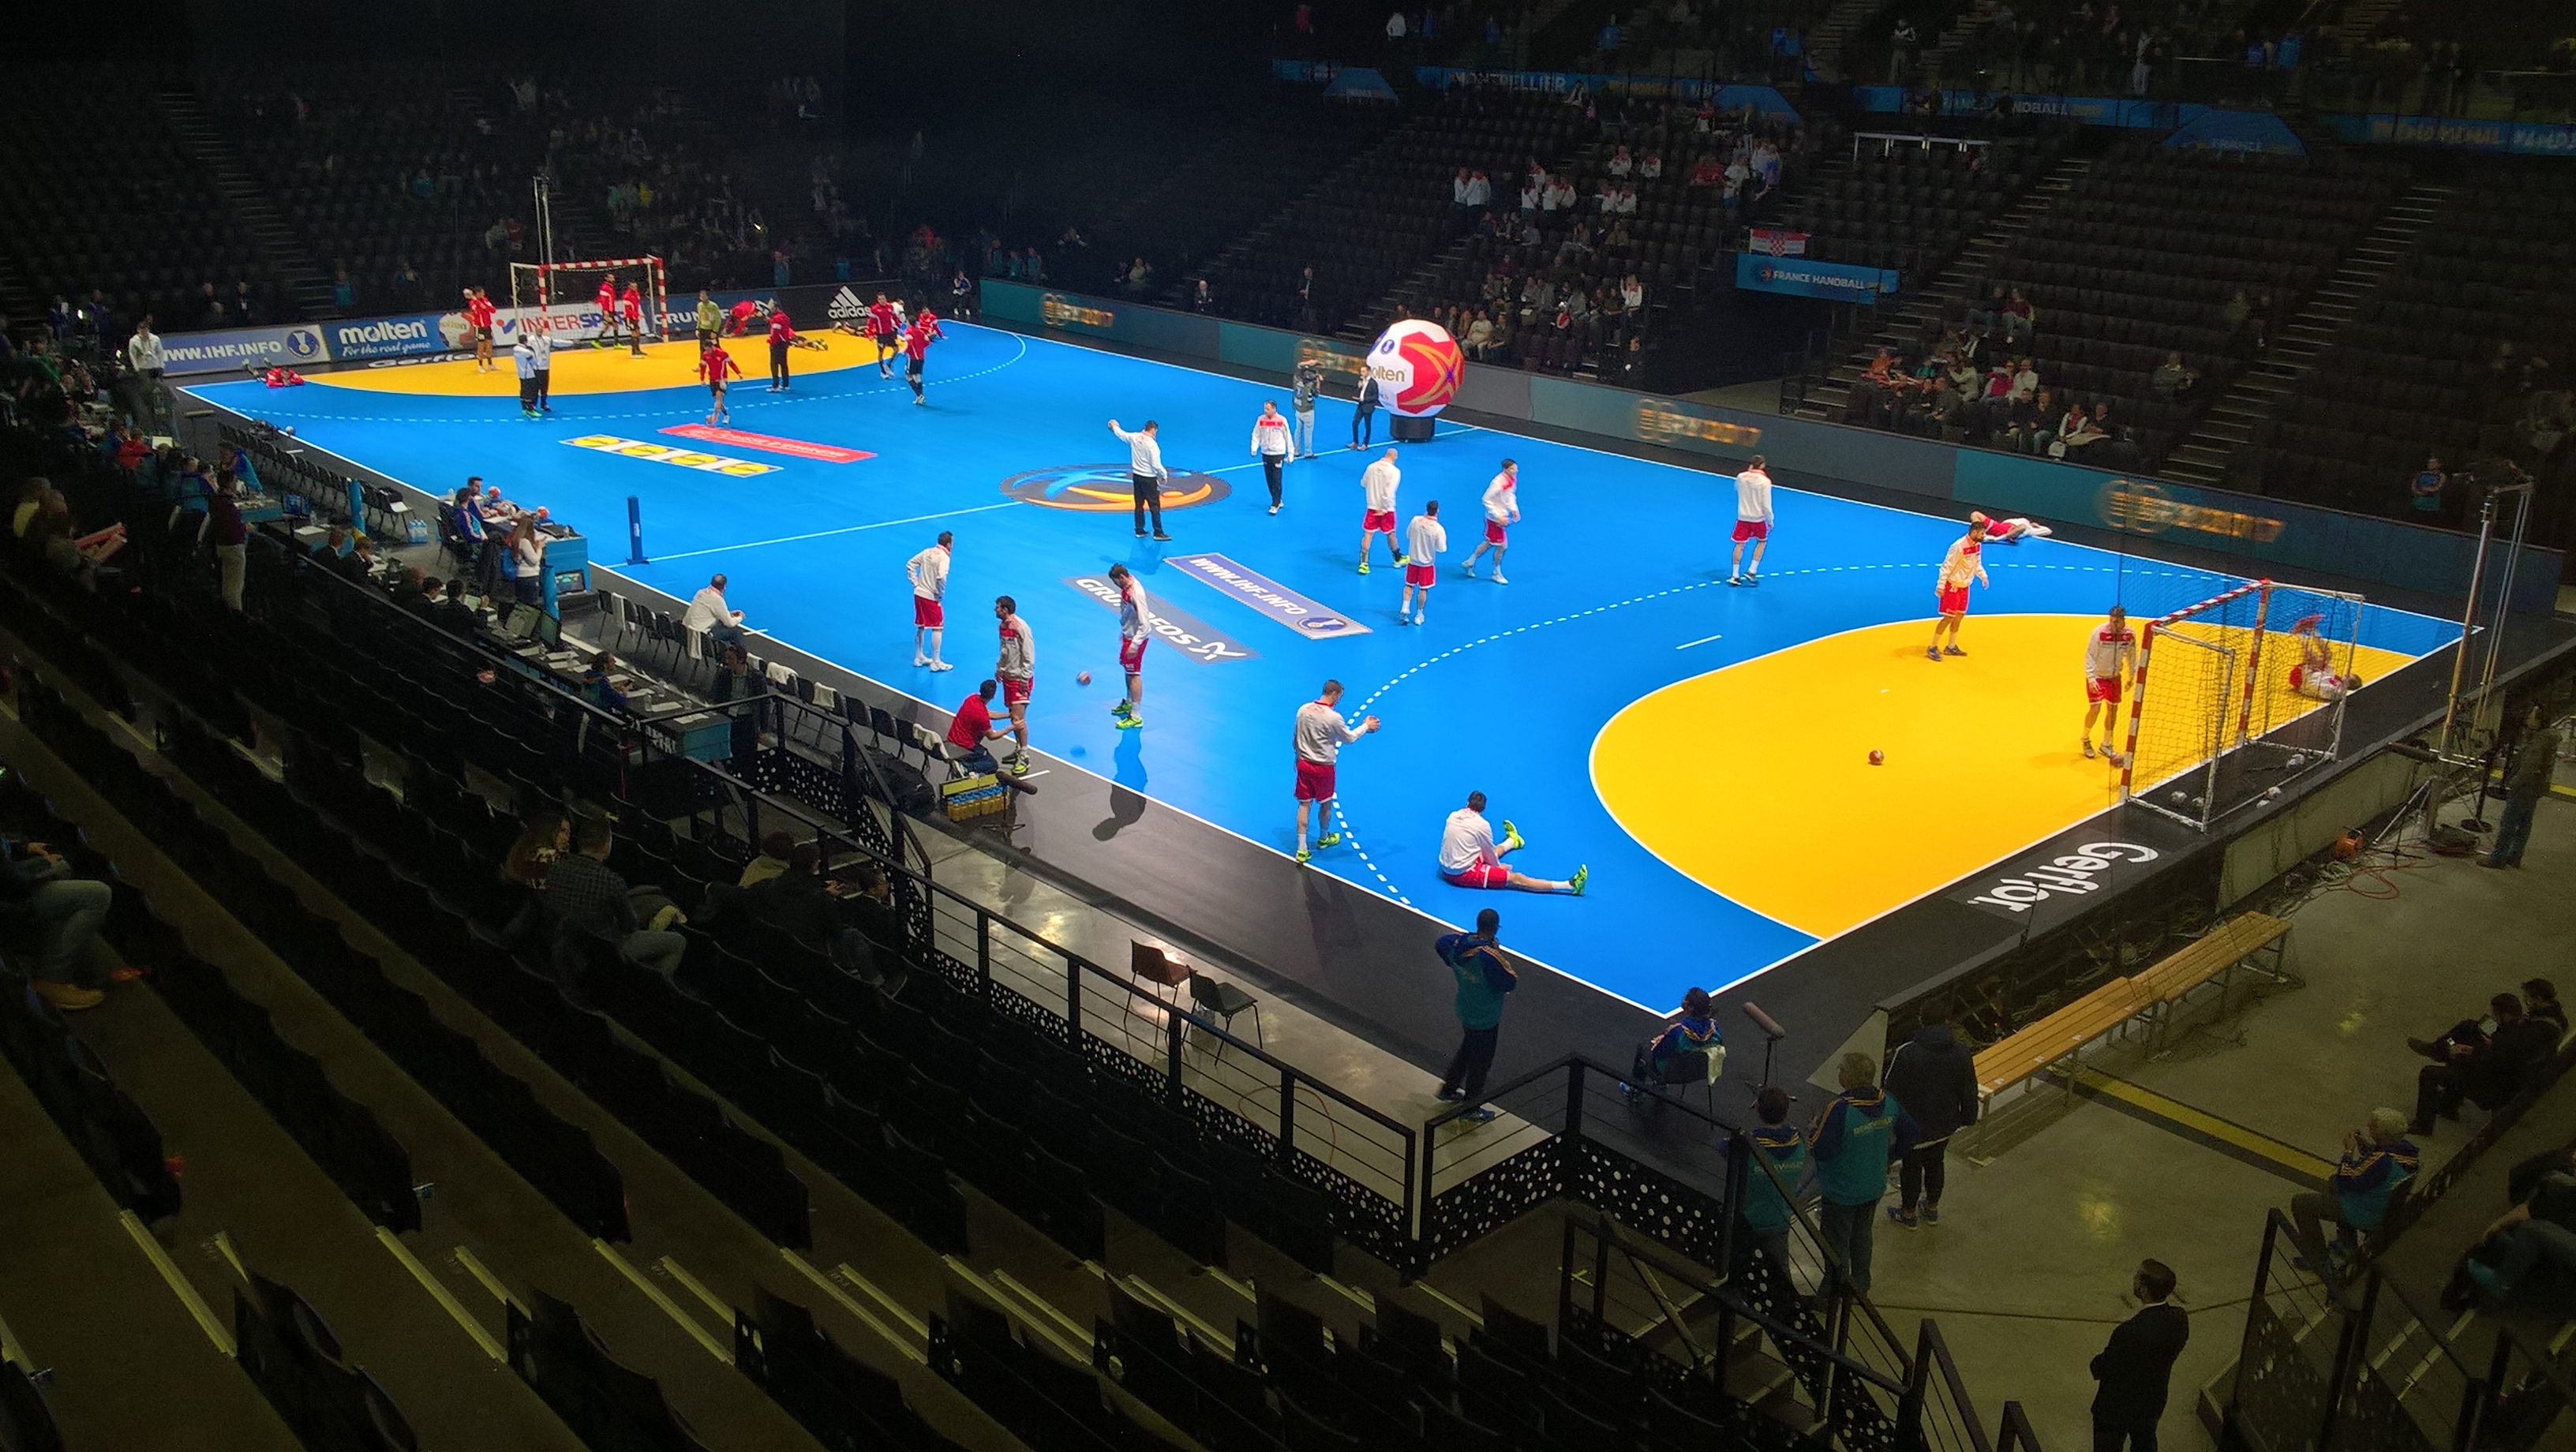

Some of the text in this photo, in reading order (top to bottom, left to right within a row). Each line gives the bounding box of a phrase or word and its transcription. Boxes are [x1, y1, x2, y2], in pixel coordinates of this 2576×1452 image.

[1773, 270, 1811, 283] FRANCE
[1813, 275, 1865, 290] HANDBALL
[827, 305, 871, 319] adidas
[339, 313, 427, 345] molten
[368, 352, 476, 369] Gerflo
[1372, 365, 1405, 382] olten
[1188, 557, 1309, 616] WWW.IHF.INFO
[1076, 578, 1201, 646] GRUFOS
